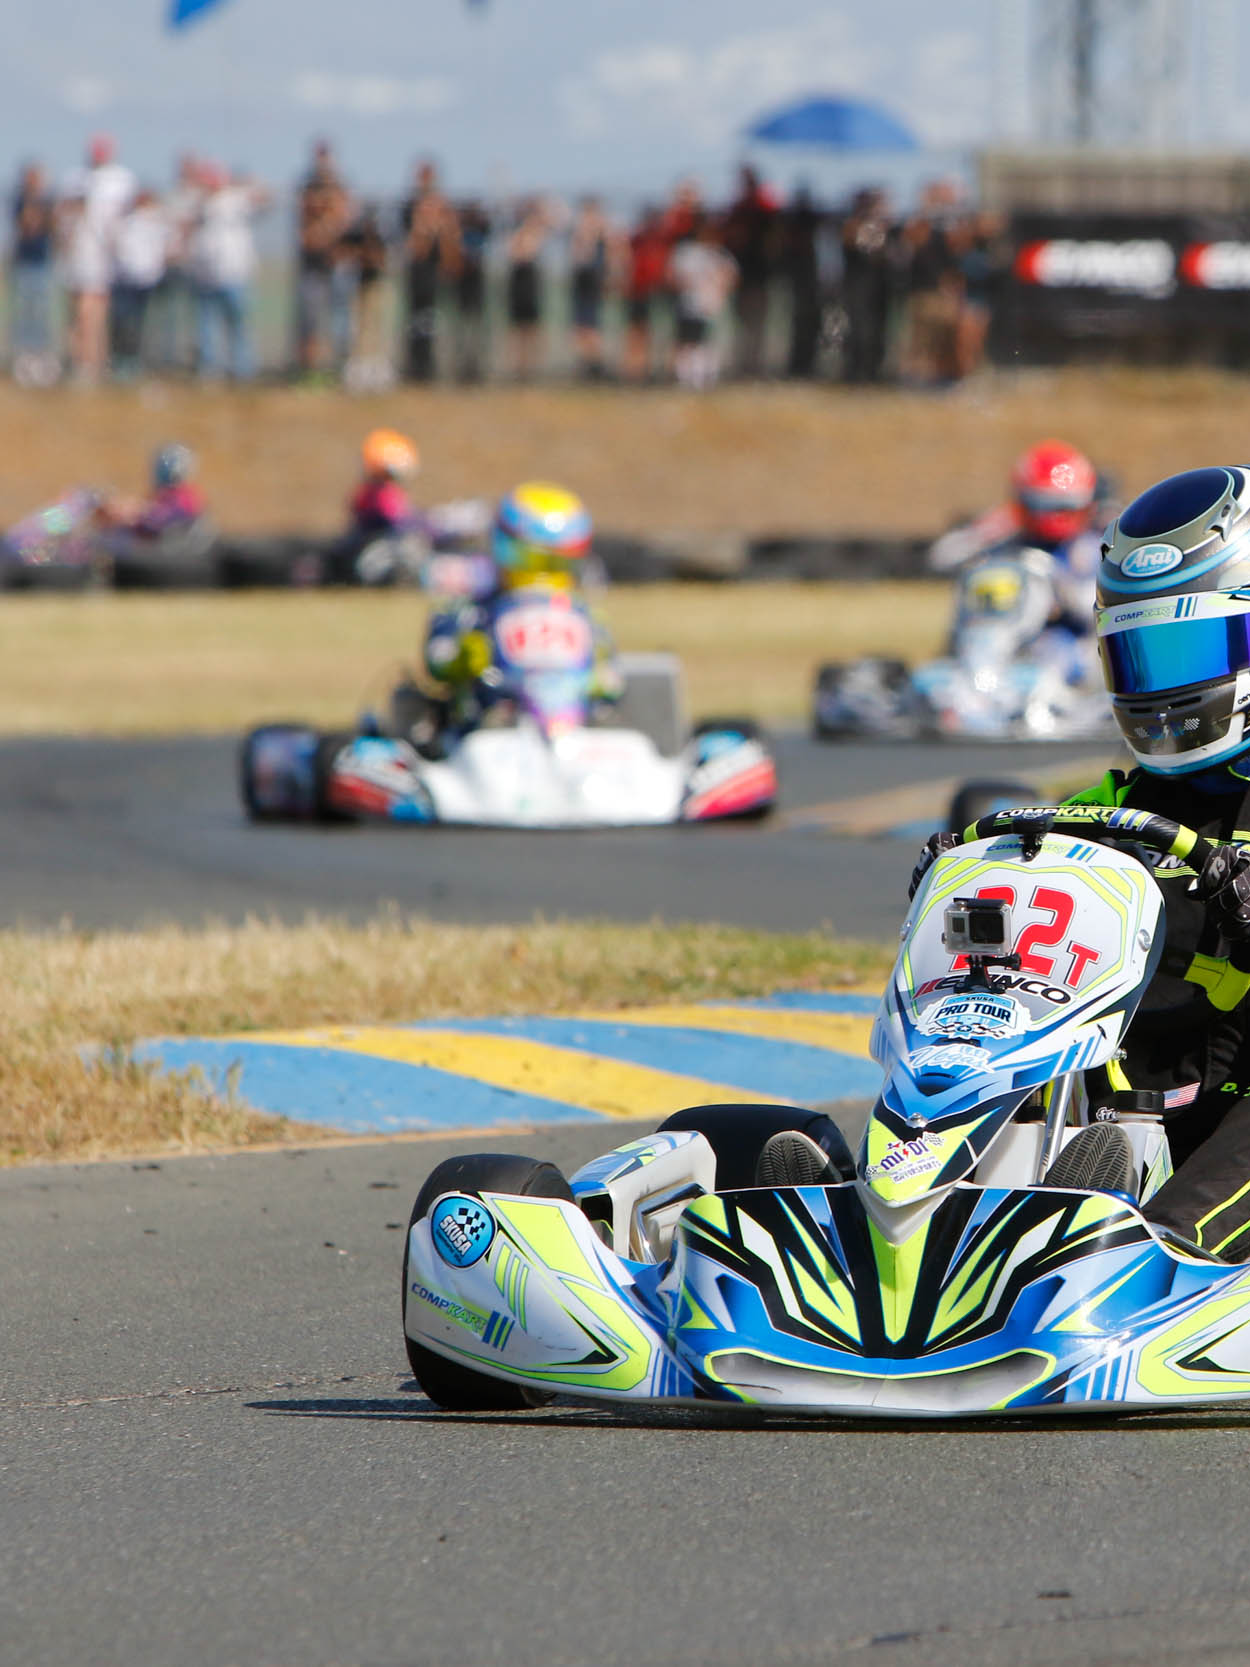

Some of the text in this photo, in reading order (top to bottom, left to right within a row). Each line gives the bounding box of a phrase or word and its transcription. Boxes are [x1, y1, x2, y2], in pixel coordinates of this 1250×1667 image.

[1127, 547, 1173, 569] Arai
[996, 807, 1114, 821] COMPKART
[934, 1003, 1011, 1023] PRO TOUR
[440, 1215, 472, 1256] SKUSA
[411, 1283, 489, 1335] COMPKART
